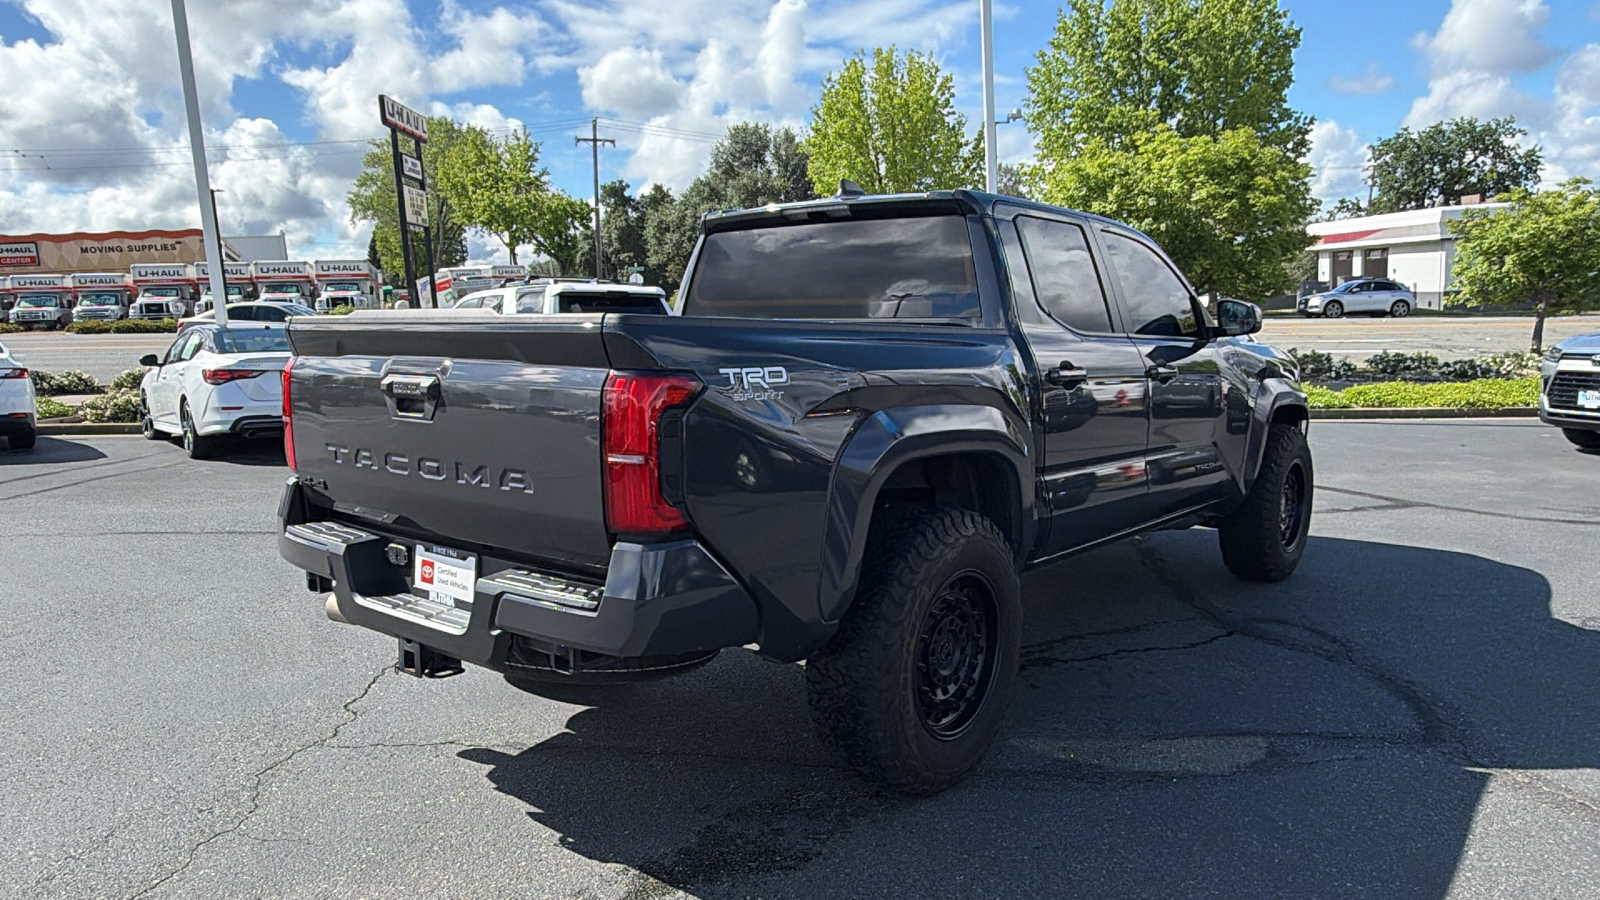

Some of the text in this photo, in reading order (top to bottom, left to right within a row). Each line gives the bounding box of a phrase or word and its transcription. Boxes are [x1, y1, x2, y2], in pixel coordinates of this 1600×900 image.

[386, 100, 427, 134] U-HAUL
[80, 243, 177, 254] MOVING SUPPLIES
[138, 269, 183, 277] U-HAUL
[260, 266, 303, 274] U-HAUL
[320, 264, 363, 272] U-HAUL
[17, 279, 59, 287] U-HAUL
[78, 277, 119, 285] U-HAUL
[719, 366, 787, 390] TRD
[733, 390, 784, 402] SPORT
[325, 443, 534, 494] TACOMA
[433, 546, 447, 555] SINCE
[437, 567, 457, 578] Certified
[437, 577, 468, 591] Used Vehicles
